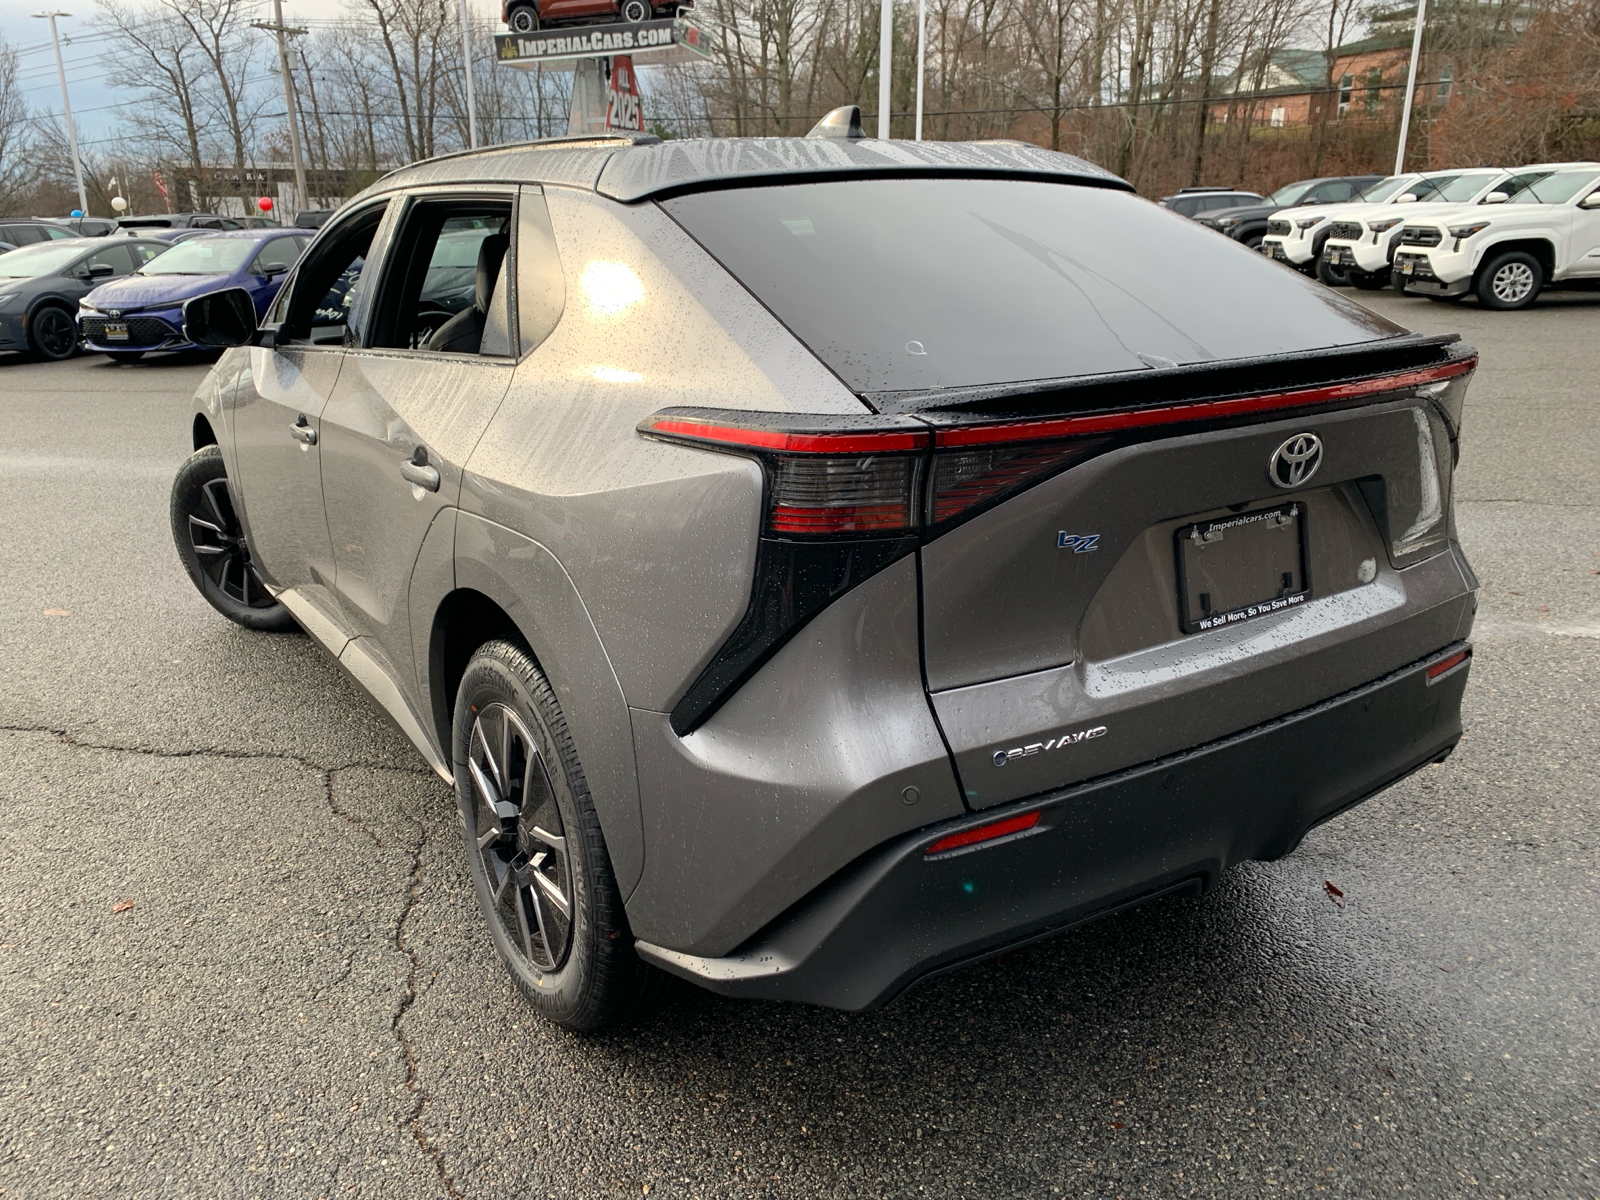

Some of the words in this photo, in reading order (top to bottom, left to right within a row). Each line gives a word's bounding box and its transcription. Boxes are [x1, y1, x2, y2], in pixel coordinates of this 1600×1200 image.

[609, 89, 640, 130] 2025
[213, 171, 265, 181] CAMRIA
[1208, 510, 1282, 532] Imperialcars.com
[1200, 619, 1212, 630] We
[1212, 615, 1227, 627] Sell
[1227, 611, 1247, 623] More,
[1248, 608, 1257, 616] So
[1257, 604, 1271, 614] You
[1271, 600, 1287, 610] Save
[1288, 594, 1304, 606] More
